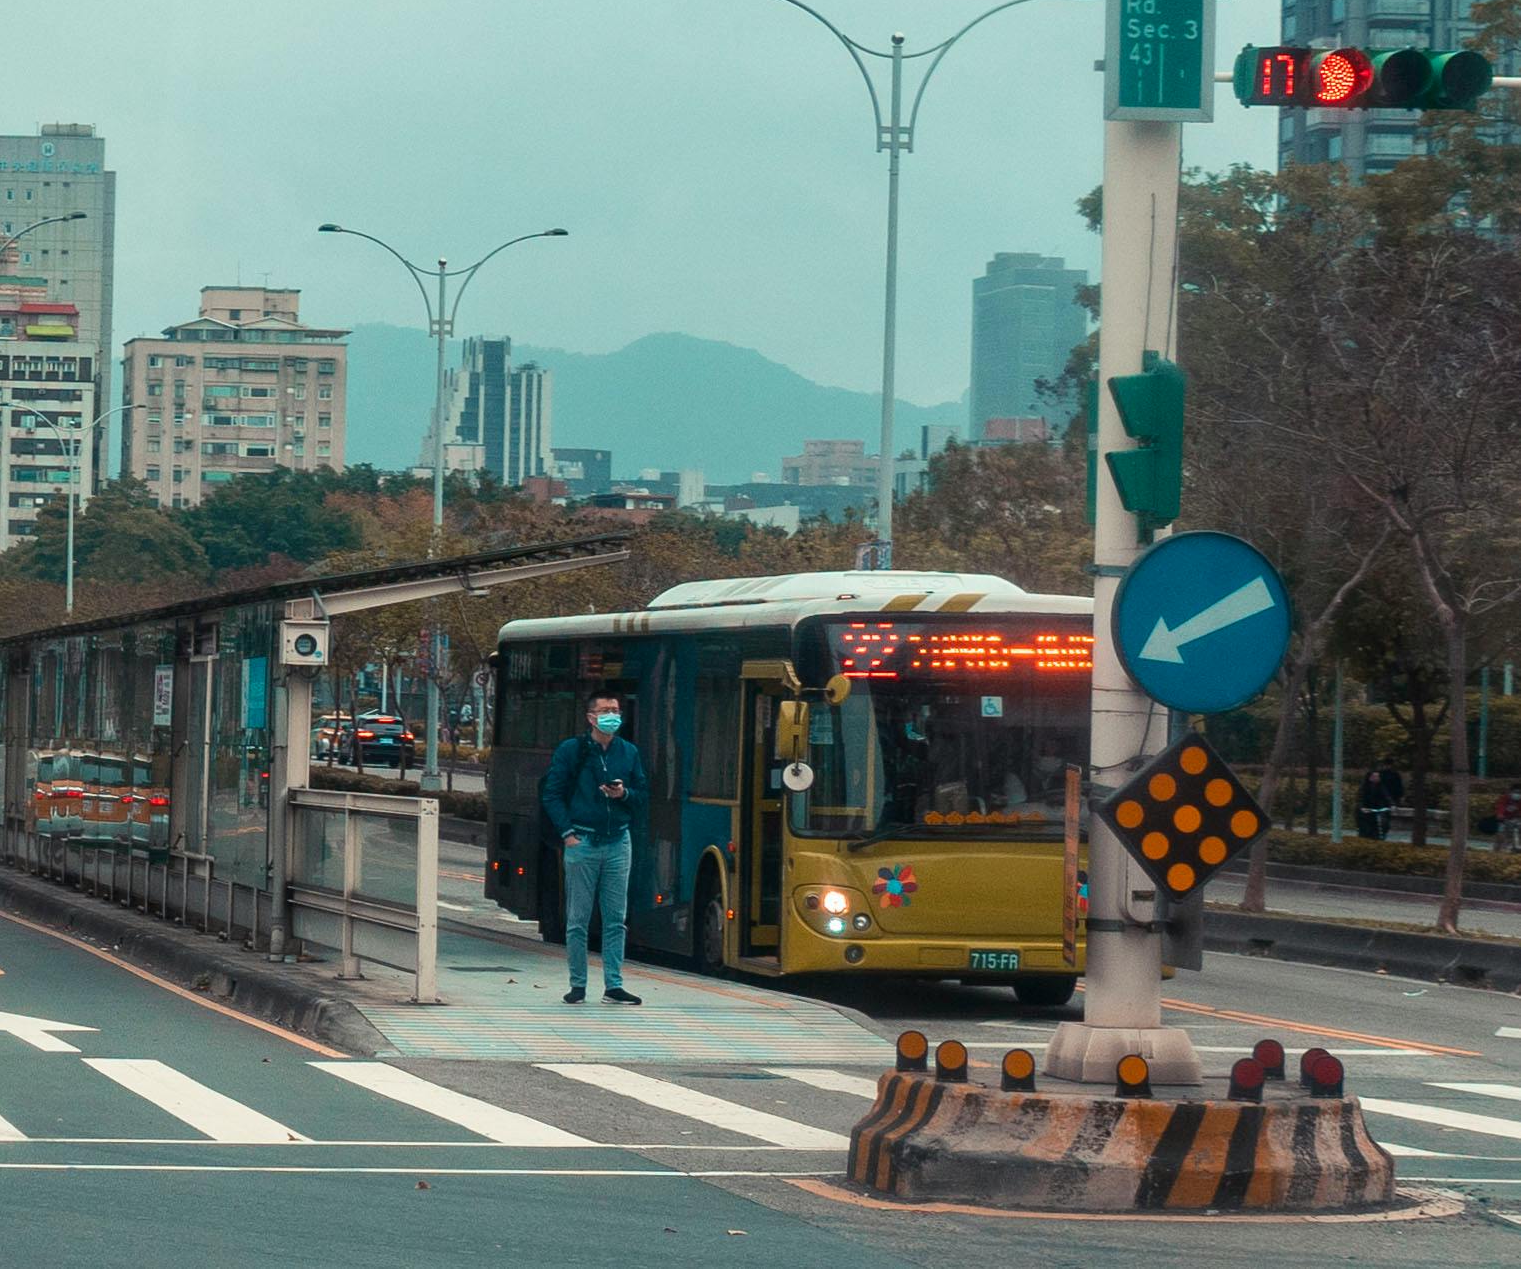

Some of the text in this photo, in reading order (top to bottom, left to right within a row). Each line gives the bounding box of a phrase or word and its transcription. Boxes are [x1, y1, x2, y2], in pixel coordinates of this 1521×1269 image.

[1126, 18, 1198, 40] Sec. 3
[1262, 54, 1295, 97] 17
[971, 953, 1019, 970] 715-FR
